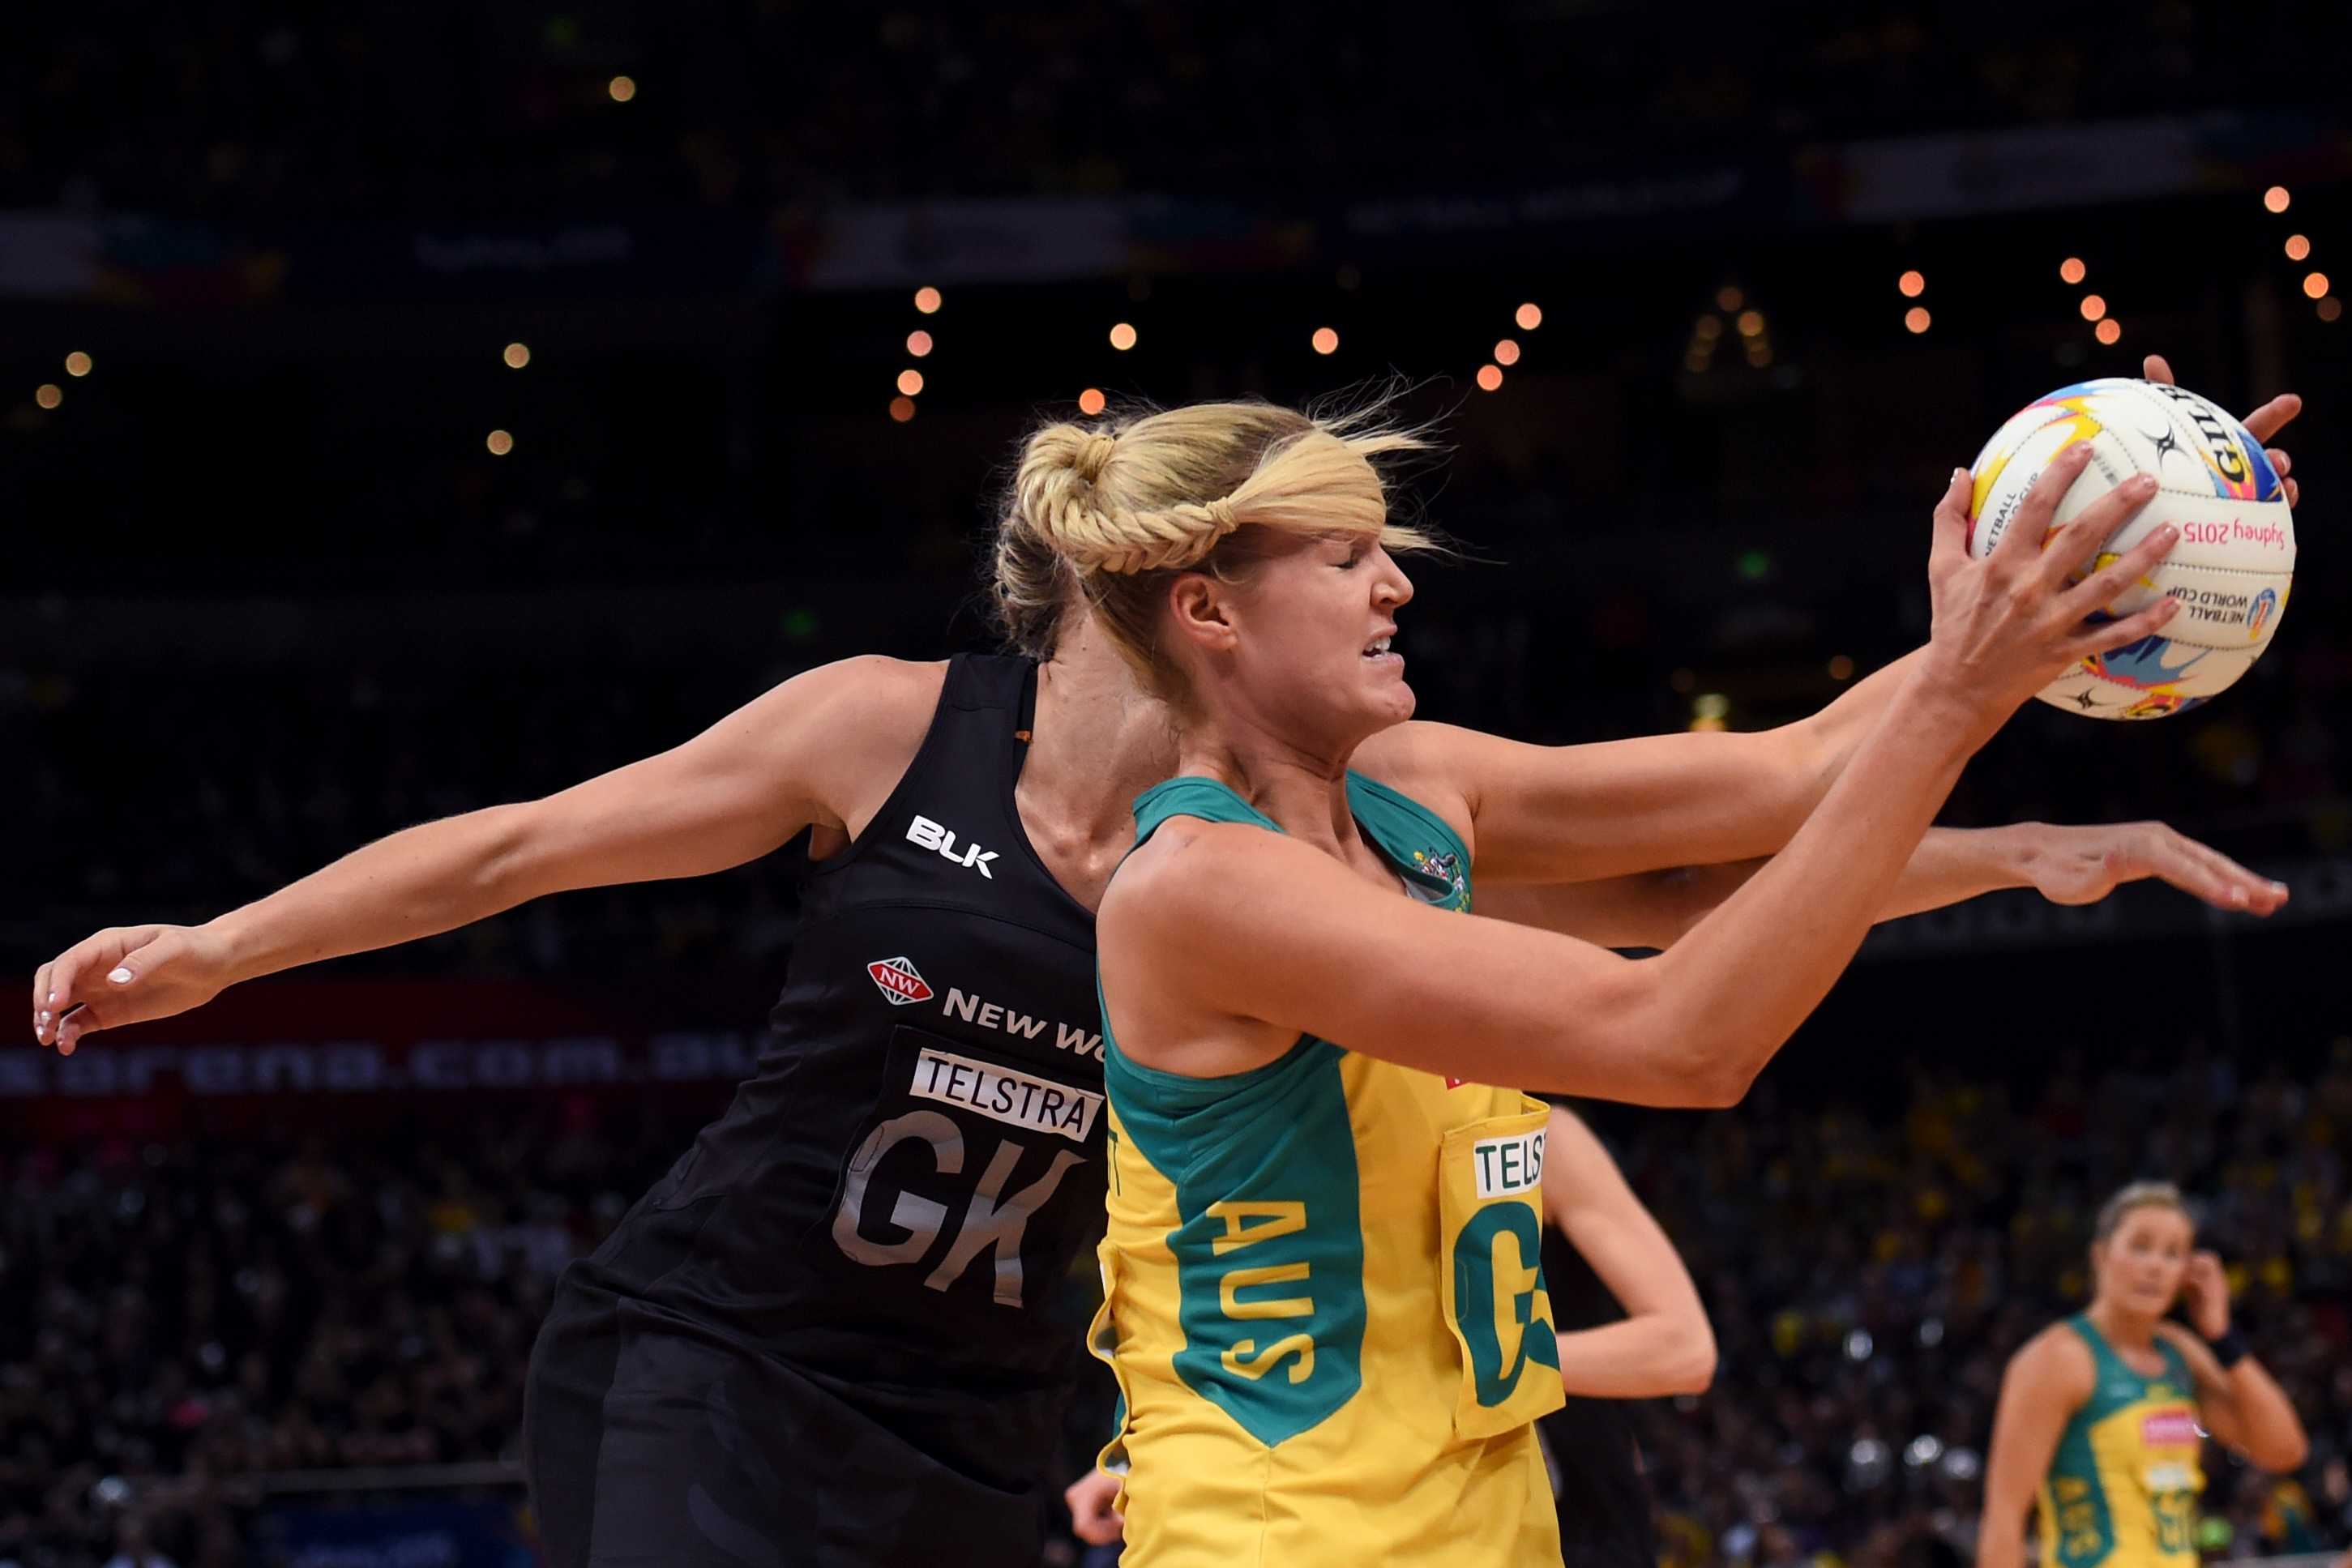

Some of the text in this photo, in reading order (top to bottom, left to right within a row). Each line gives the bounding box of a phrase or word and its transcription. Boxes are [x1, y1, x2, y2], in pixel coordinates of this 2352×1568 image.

[2183, 518, 2285, 550] Sydney 2015
[2190, 605, 2245, 624] NETBALL
[2200, 591, 2247, 608] WORLD
[905, 814, 1000, 880] BLK
[879, 967, 921, 994] NW
[943, 987, 1048, 1040] NEW
[927, 1056, 1088, 1133] TELSTRA
[1475, 1133, 1546, 1193] TELS
[832, 1110, 1089, 1309] GK
[1206, 1200, 1315, 1385] AUS
